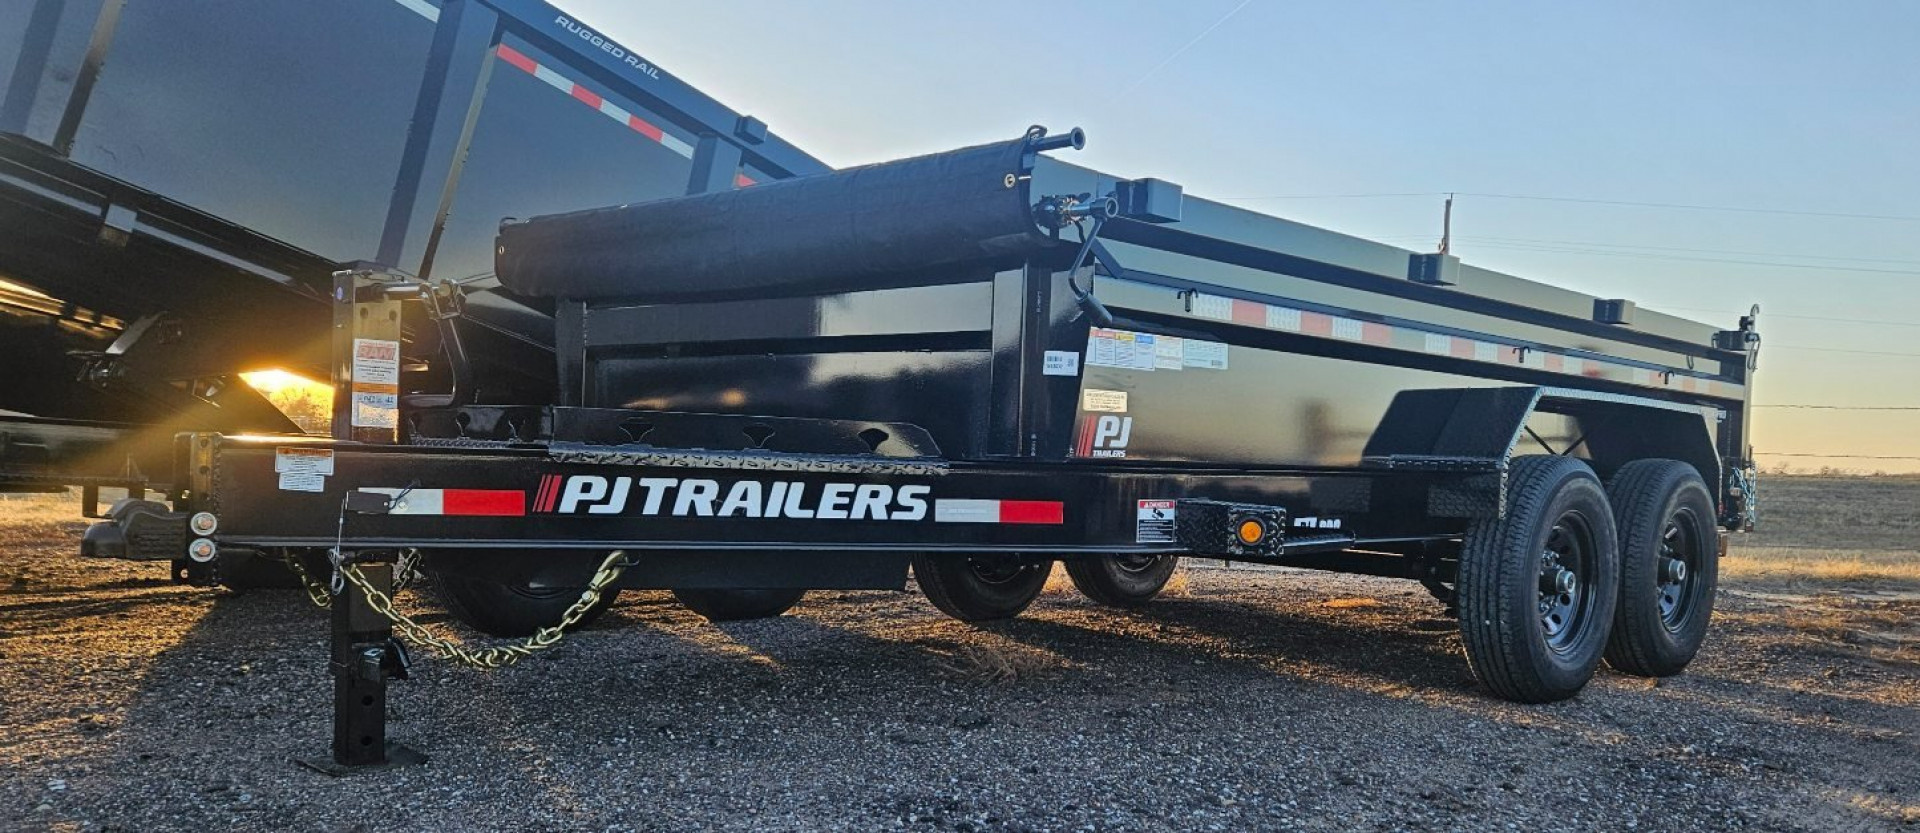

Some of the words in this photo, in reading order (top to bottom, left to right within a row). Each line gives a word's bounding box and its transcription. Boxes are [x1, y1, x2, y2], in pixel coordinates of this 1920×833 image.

[555, 15, 625, 58] RUGGED
[624, 54, 660, 80] RAIL
[1094, 415, 1133, 449] PJ
[1092, 449, 1127, 458] TRAILERS
[559, 475, 632, 514] PJ
[640, 477, 931, 521] TRAILERS
